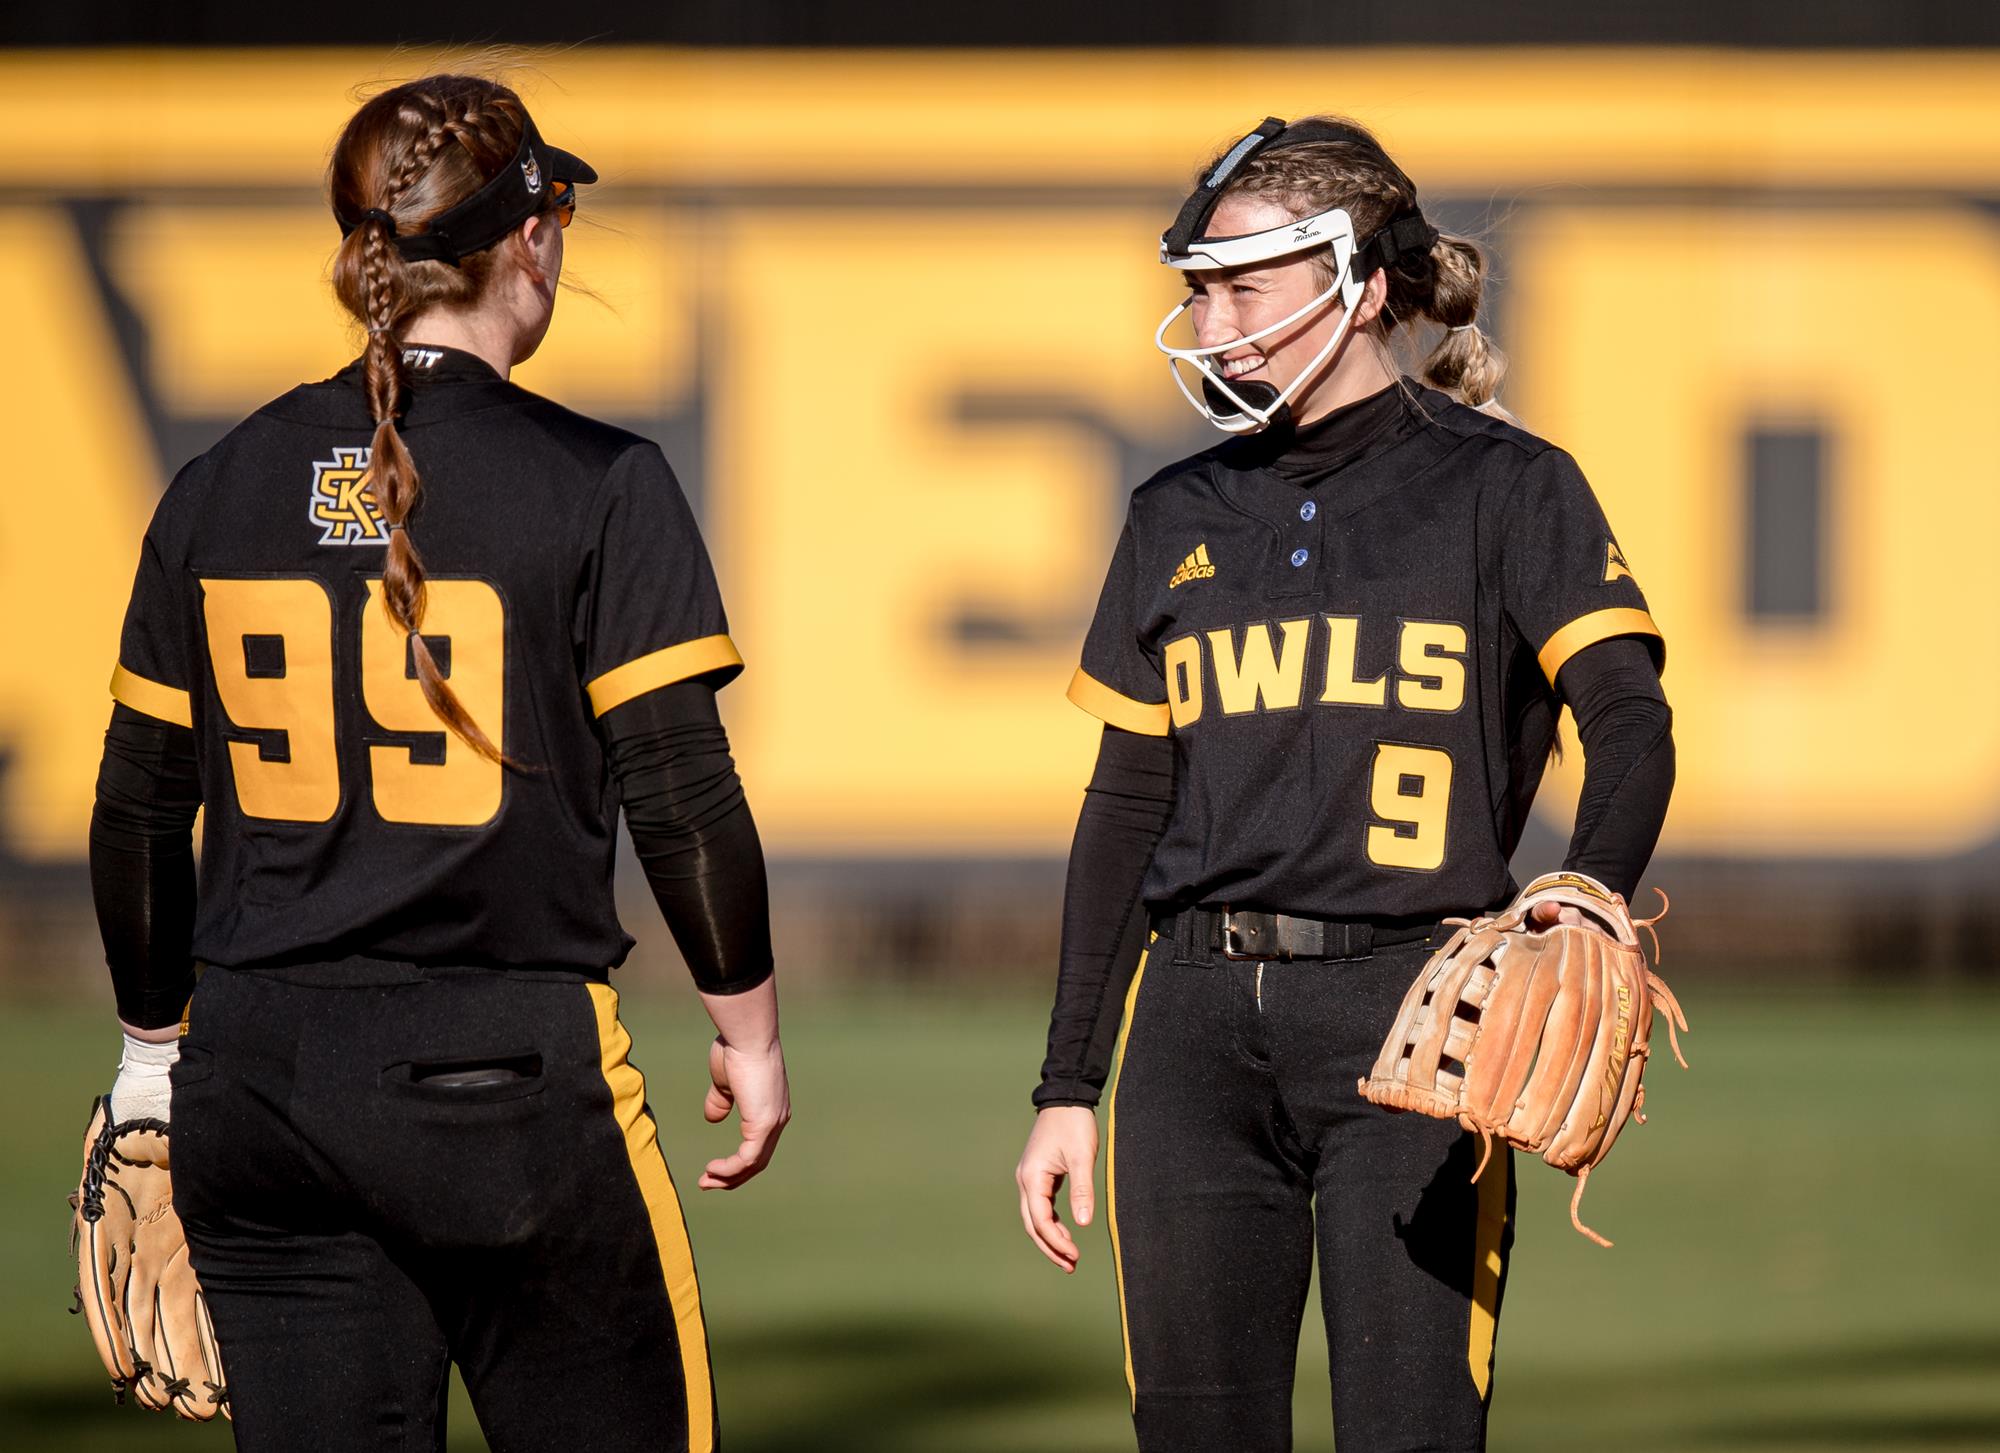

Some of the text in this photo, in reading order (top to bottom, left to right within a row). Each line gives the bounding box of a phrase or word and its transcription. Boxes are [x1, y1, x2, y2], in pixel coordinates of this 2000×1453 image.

[1293, 231, 1322, 243] Mizuno
[1168, 564, 1216, 589] adidas
[198, 576, 506, 828] 99
[1163, 616, 1468, 730] OWLS
[1366, 742, 1455, 872] 9
